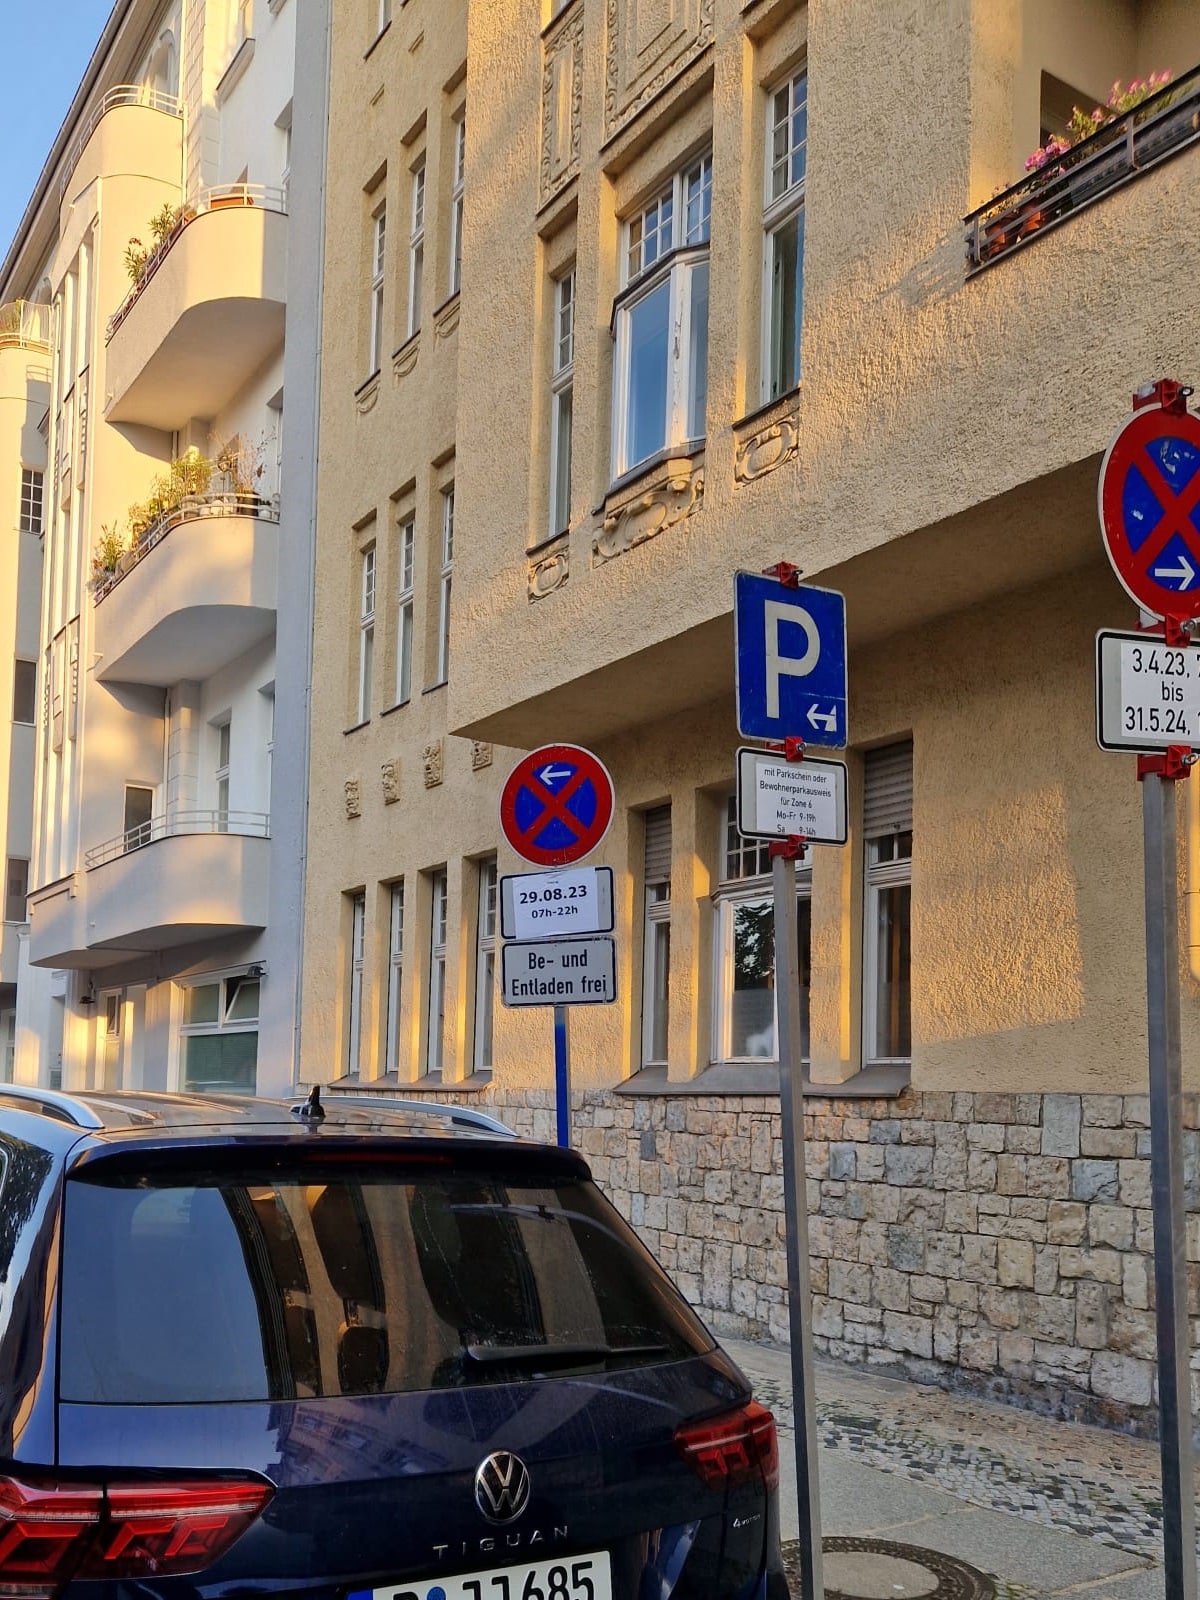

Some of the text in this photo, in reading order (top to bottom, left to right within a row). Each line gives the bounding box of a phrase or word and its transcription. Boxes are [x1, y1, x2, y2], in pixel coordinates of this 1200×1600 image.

[765, 600, 820, 719] P
[1132, 648, 1190, 678] 3.4.23,
[1161, 681, 1184, 702] bis
[1125, 706, 1191, 735] 31.5.24,
[764, 768, 828, 783] mit Parkschein oder
[760, 780, 832, 797] Bewohnerparkausweis
[791, 798, 807, 808] Zone
[808, 800, 813, 808] 6
[776, 810, 796, 820] Mo-Fr
[777, 824, 786, 833] Sa
[520, 885, 588, 904] 29.08.23
[532, 905, 578, 918] 07h-22h
[528, 949, 588, 969] Be- und
[512, 974, 606, 996] Entladen frei
[432, 1525, 568, 1560] TIGUAN
